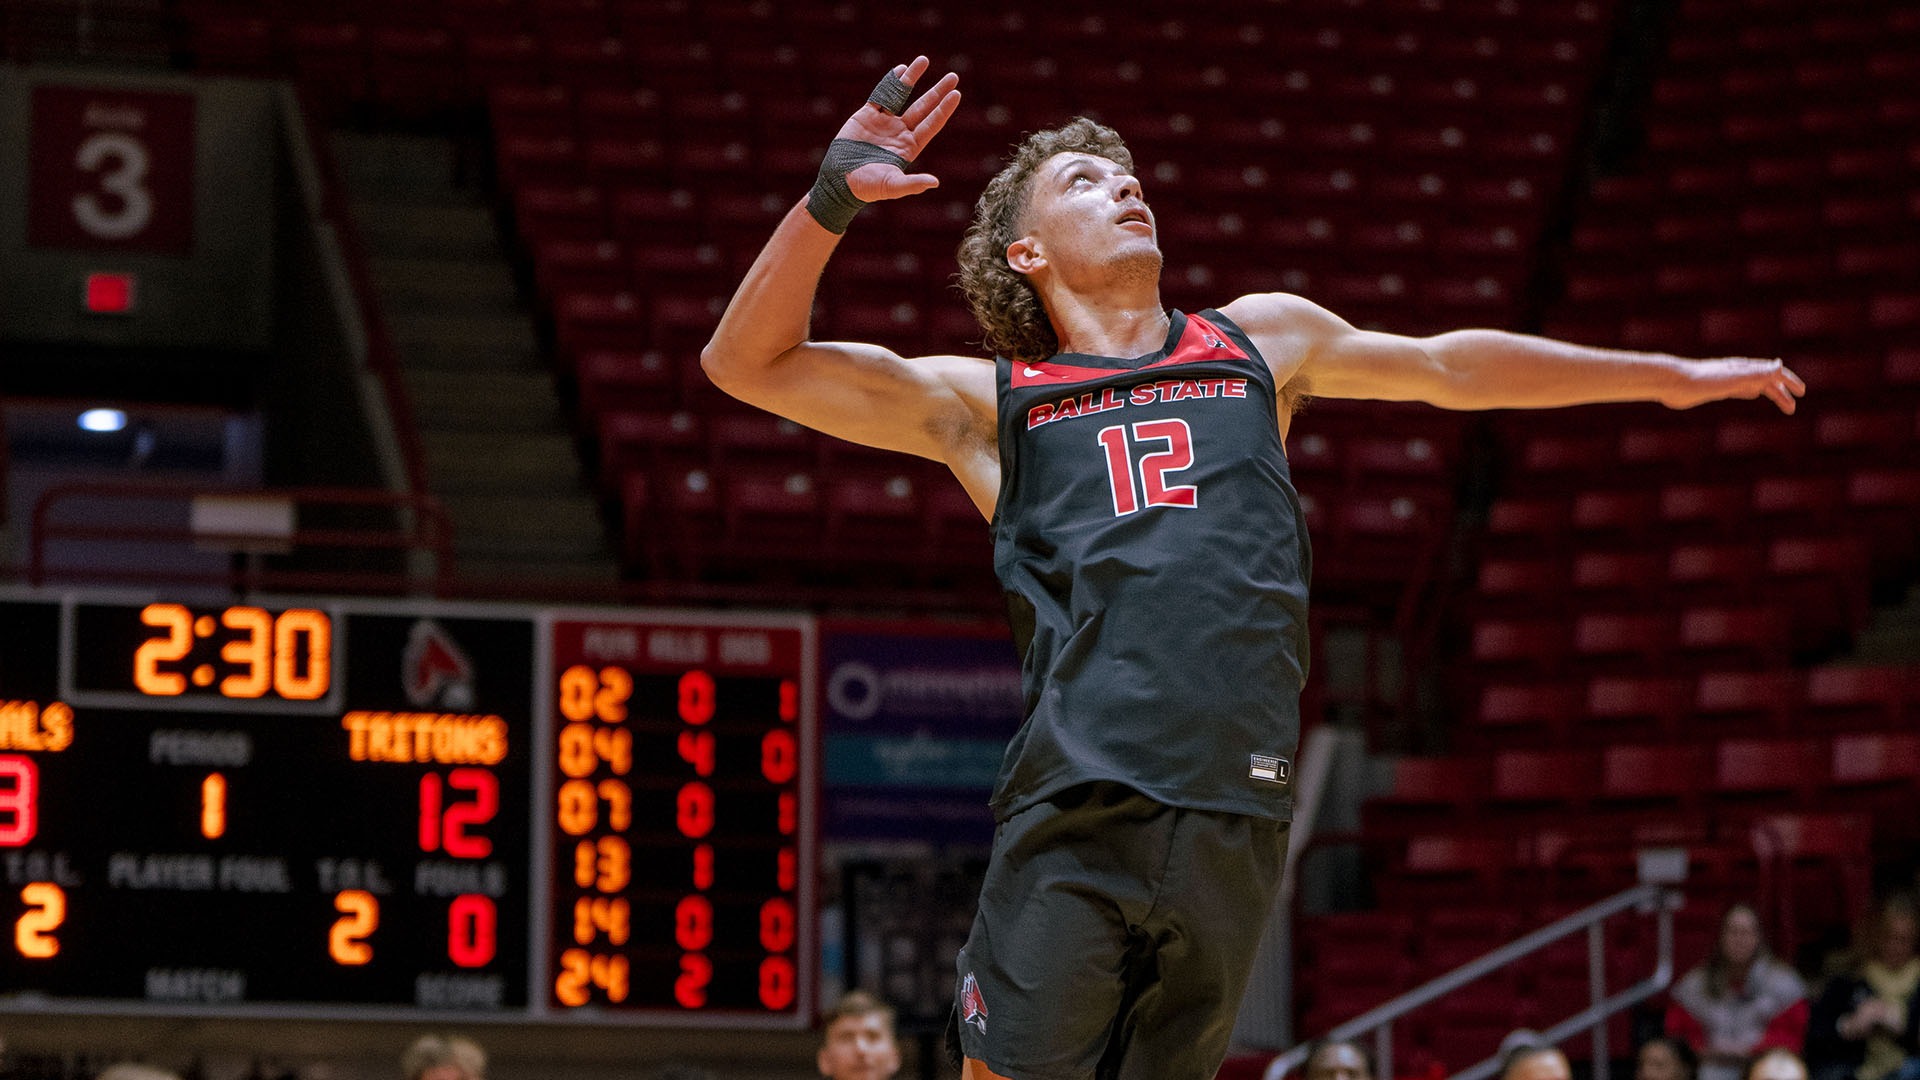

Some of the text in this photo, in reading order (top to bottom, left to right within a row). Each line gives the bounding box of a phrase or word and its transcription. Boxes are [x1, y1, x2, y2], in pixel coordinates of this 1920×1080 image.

[72, 133, 153, 237] 3
[1028, 379, 1248, 431] BALL STATE
[1097, 418, 1198, 517] 12
[134, 603, 331, 700] 2:30
[560, 666, 632, 722] 02
[678, 670, 715, 725] 0
[779, 680, 797, 722] 1
[149, 731, 252, 767] PERIOD
[342, 711, 508, 766] TRITONS
[559, 723, 797, 784] 04 4 0
[1280, 766, 1286, 778] L
[201, 772, 228, 839] 1
[418, 769, 499, 859] 12
[558, 779, 797, 838] 07 0 1
[107, 853, 290, 893] PLAYER FOUL
[414, 861, 505, 896] FOULS
[575, 836, 796, 893] 13 1 1
[15, 882, 66, 959] 2
[328, 890, 380, 966] 2
[448, 894, 497, 968] 0
[574, 896, 796, 953] 14 0 0
[145, 966, 246, 1000] MATCH
[415, 973, 503, 1006] SCORE
[556, 949, 796, 1011] 24 2 0
